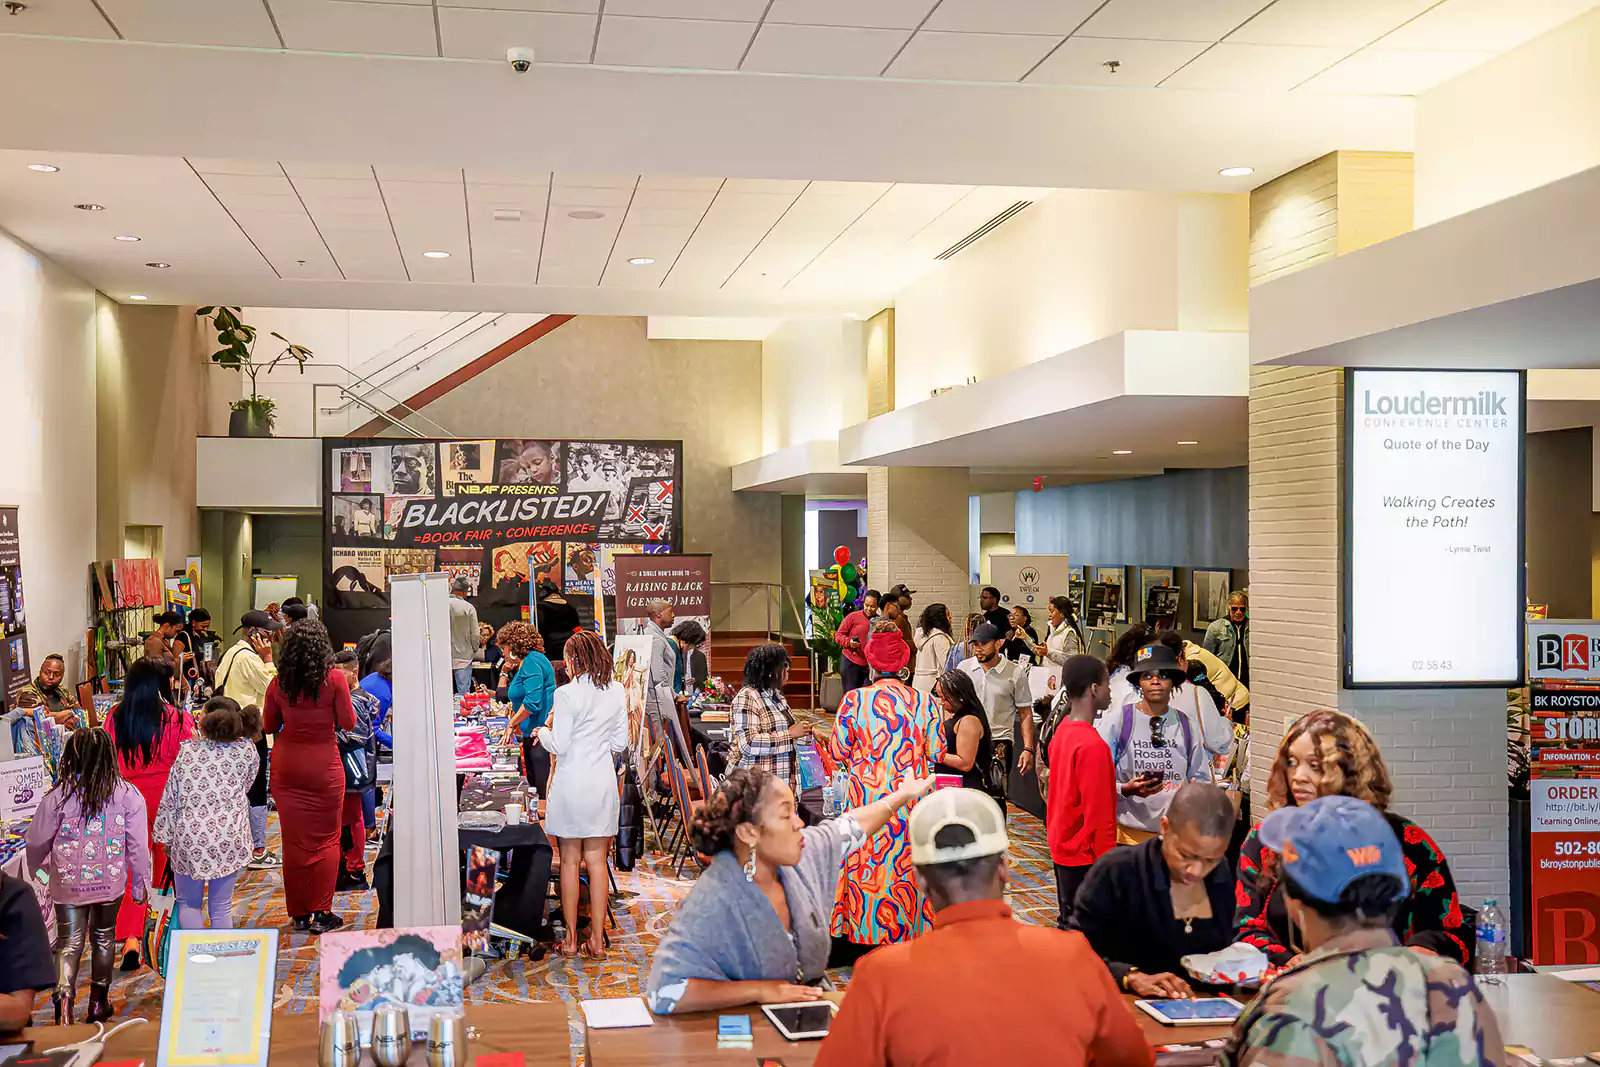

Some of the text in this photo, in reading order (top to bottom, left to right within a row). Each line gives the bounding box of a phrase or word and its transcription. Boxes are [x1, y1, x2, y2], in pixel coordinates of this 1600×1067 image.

[1364, 390, 1507, 415] Loudermilk
[1364, 418, 1508, 428] CONFERENCE CENTER
[1383, 438, 1490, 452] Quote of the Day
[457, 472, 473, 481] The
[458, 485, 559, 495] NBAF PRESENTS:
[1382, 495, 1496, 511] Walking Creates
[403, 493, 606, 528] BLACKLISTED!
[1406, 515, 1469, 528] the Path!
[464, 529, 493, 541] FAIR
[626, 581, 704, 592] RAISING BLACK
[680, 596, 704, 605] MEN
[1534, 695, 1549, 706] BK
[1134, 749, 1172, 759] Rosa&
[1543, 753, 1590, 761] INFORMATION
[8, 781, 44, 794] ENGAGED
[1547, 786, 1599, 800] ORDER
[1545, 802, 1600, 813] http://bit.ly/
